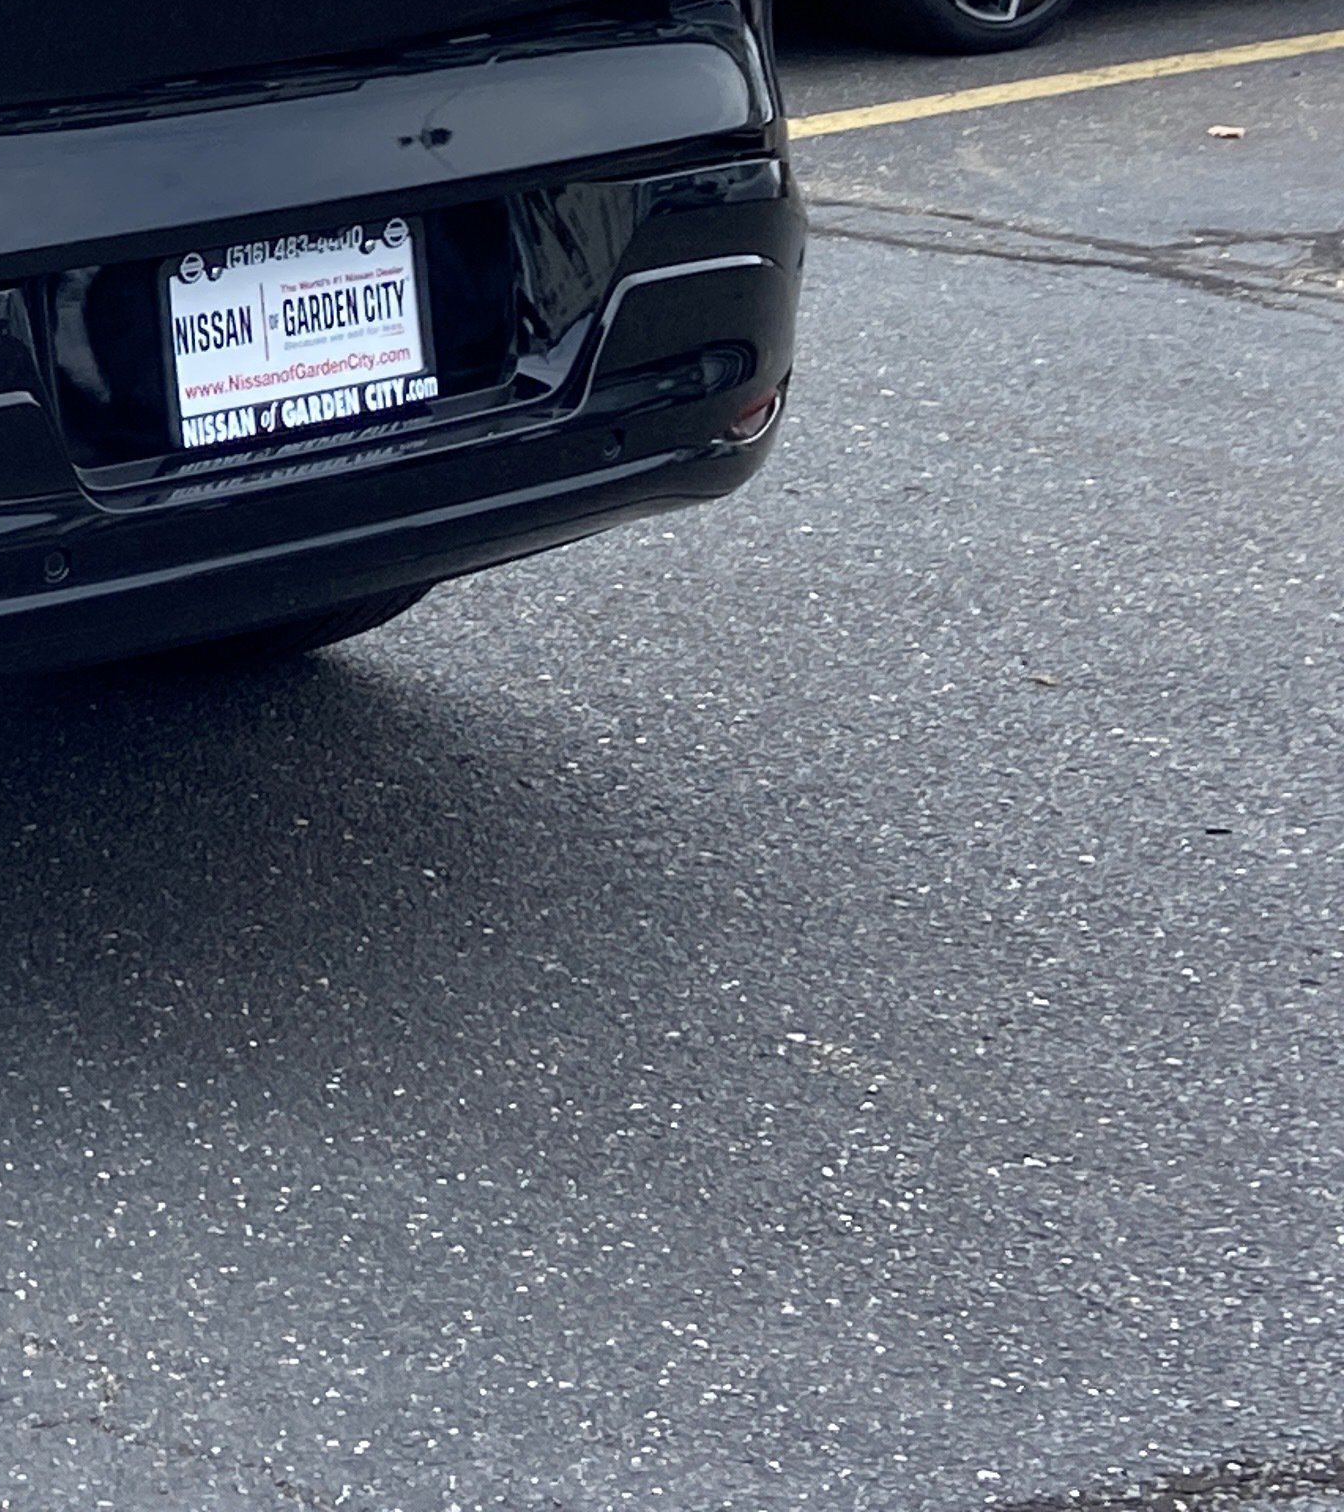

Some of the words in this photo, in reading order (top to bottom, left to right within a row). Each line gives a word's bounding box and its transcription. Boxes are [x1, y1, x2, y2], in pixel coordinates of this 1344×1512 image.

[175, 305, 253, 356] NISSAN
[283, 287, 360, 337] GARDEN
[363, 279, 406, 323] CITY
[185, 347, 411, 399] www.NissanofGardenCity.com
[182, 406, 257, 449] NISSAN
[261, 399, 279, 433] of
[281, 387, 361, 428] GARDEN
[364, 376, 439, 412] CITY.com
